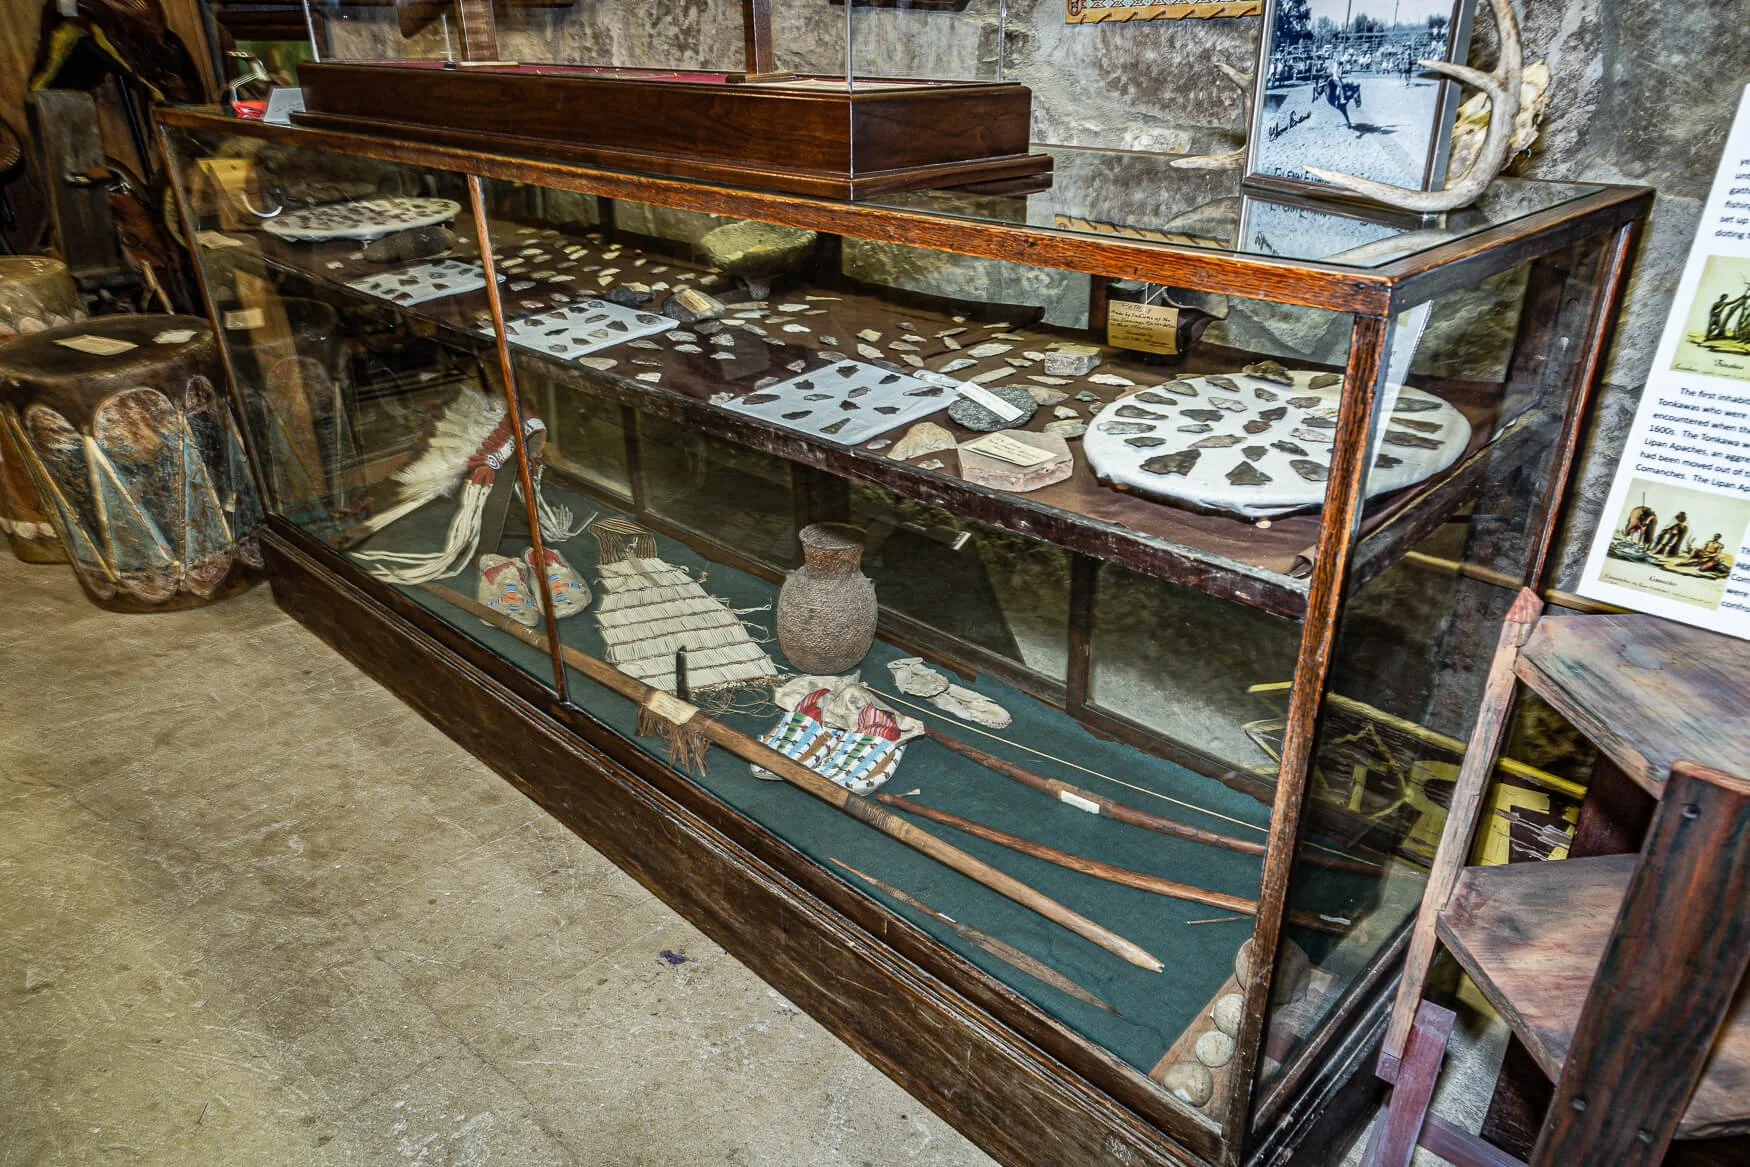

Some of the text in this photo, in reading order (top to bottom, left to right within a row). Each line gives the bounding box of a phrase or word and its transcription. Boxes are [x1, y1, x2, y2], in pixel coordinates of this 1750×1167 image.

[1680, 387, 1697, 397] The
[1698, 390, 1717, 400] first
[1702, 406, 1722, 415] who
[1724, 410, 1748, 419] were
[1652, 412, 1710, 428] encountered
[1711, 422, 1737, 433] when
[1682, 429, 1699, 440] The
[1640, 451, 1657, 460] had
[1658, 455, 1681, 465] been
[1682, 460, 1713, 471] moved
[1714, 465, 1731, 474] out
[1732, 468, 1744, 476] of
[1692, 473, 1709, 484] The
